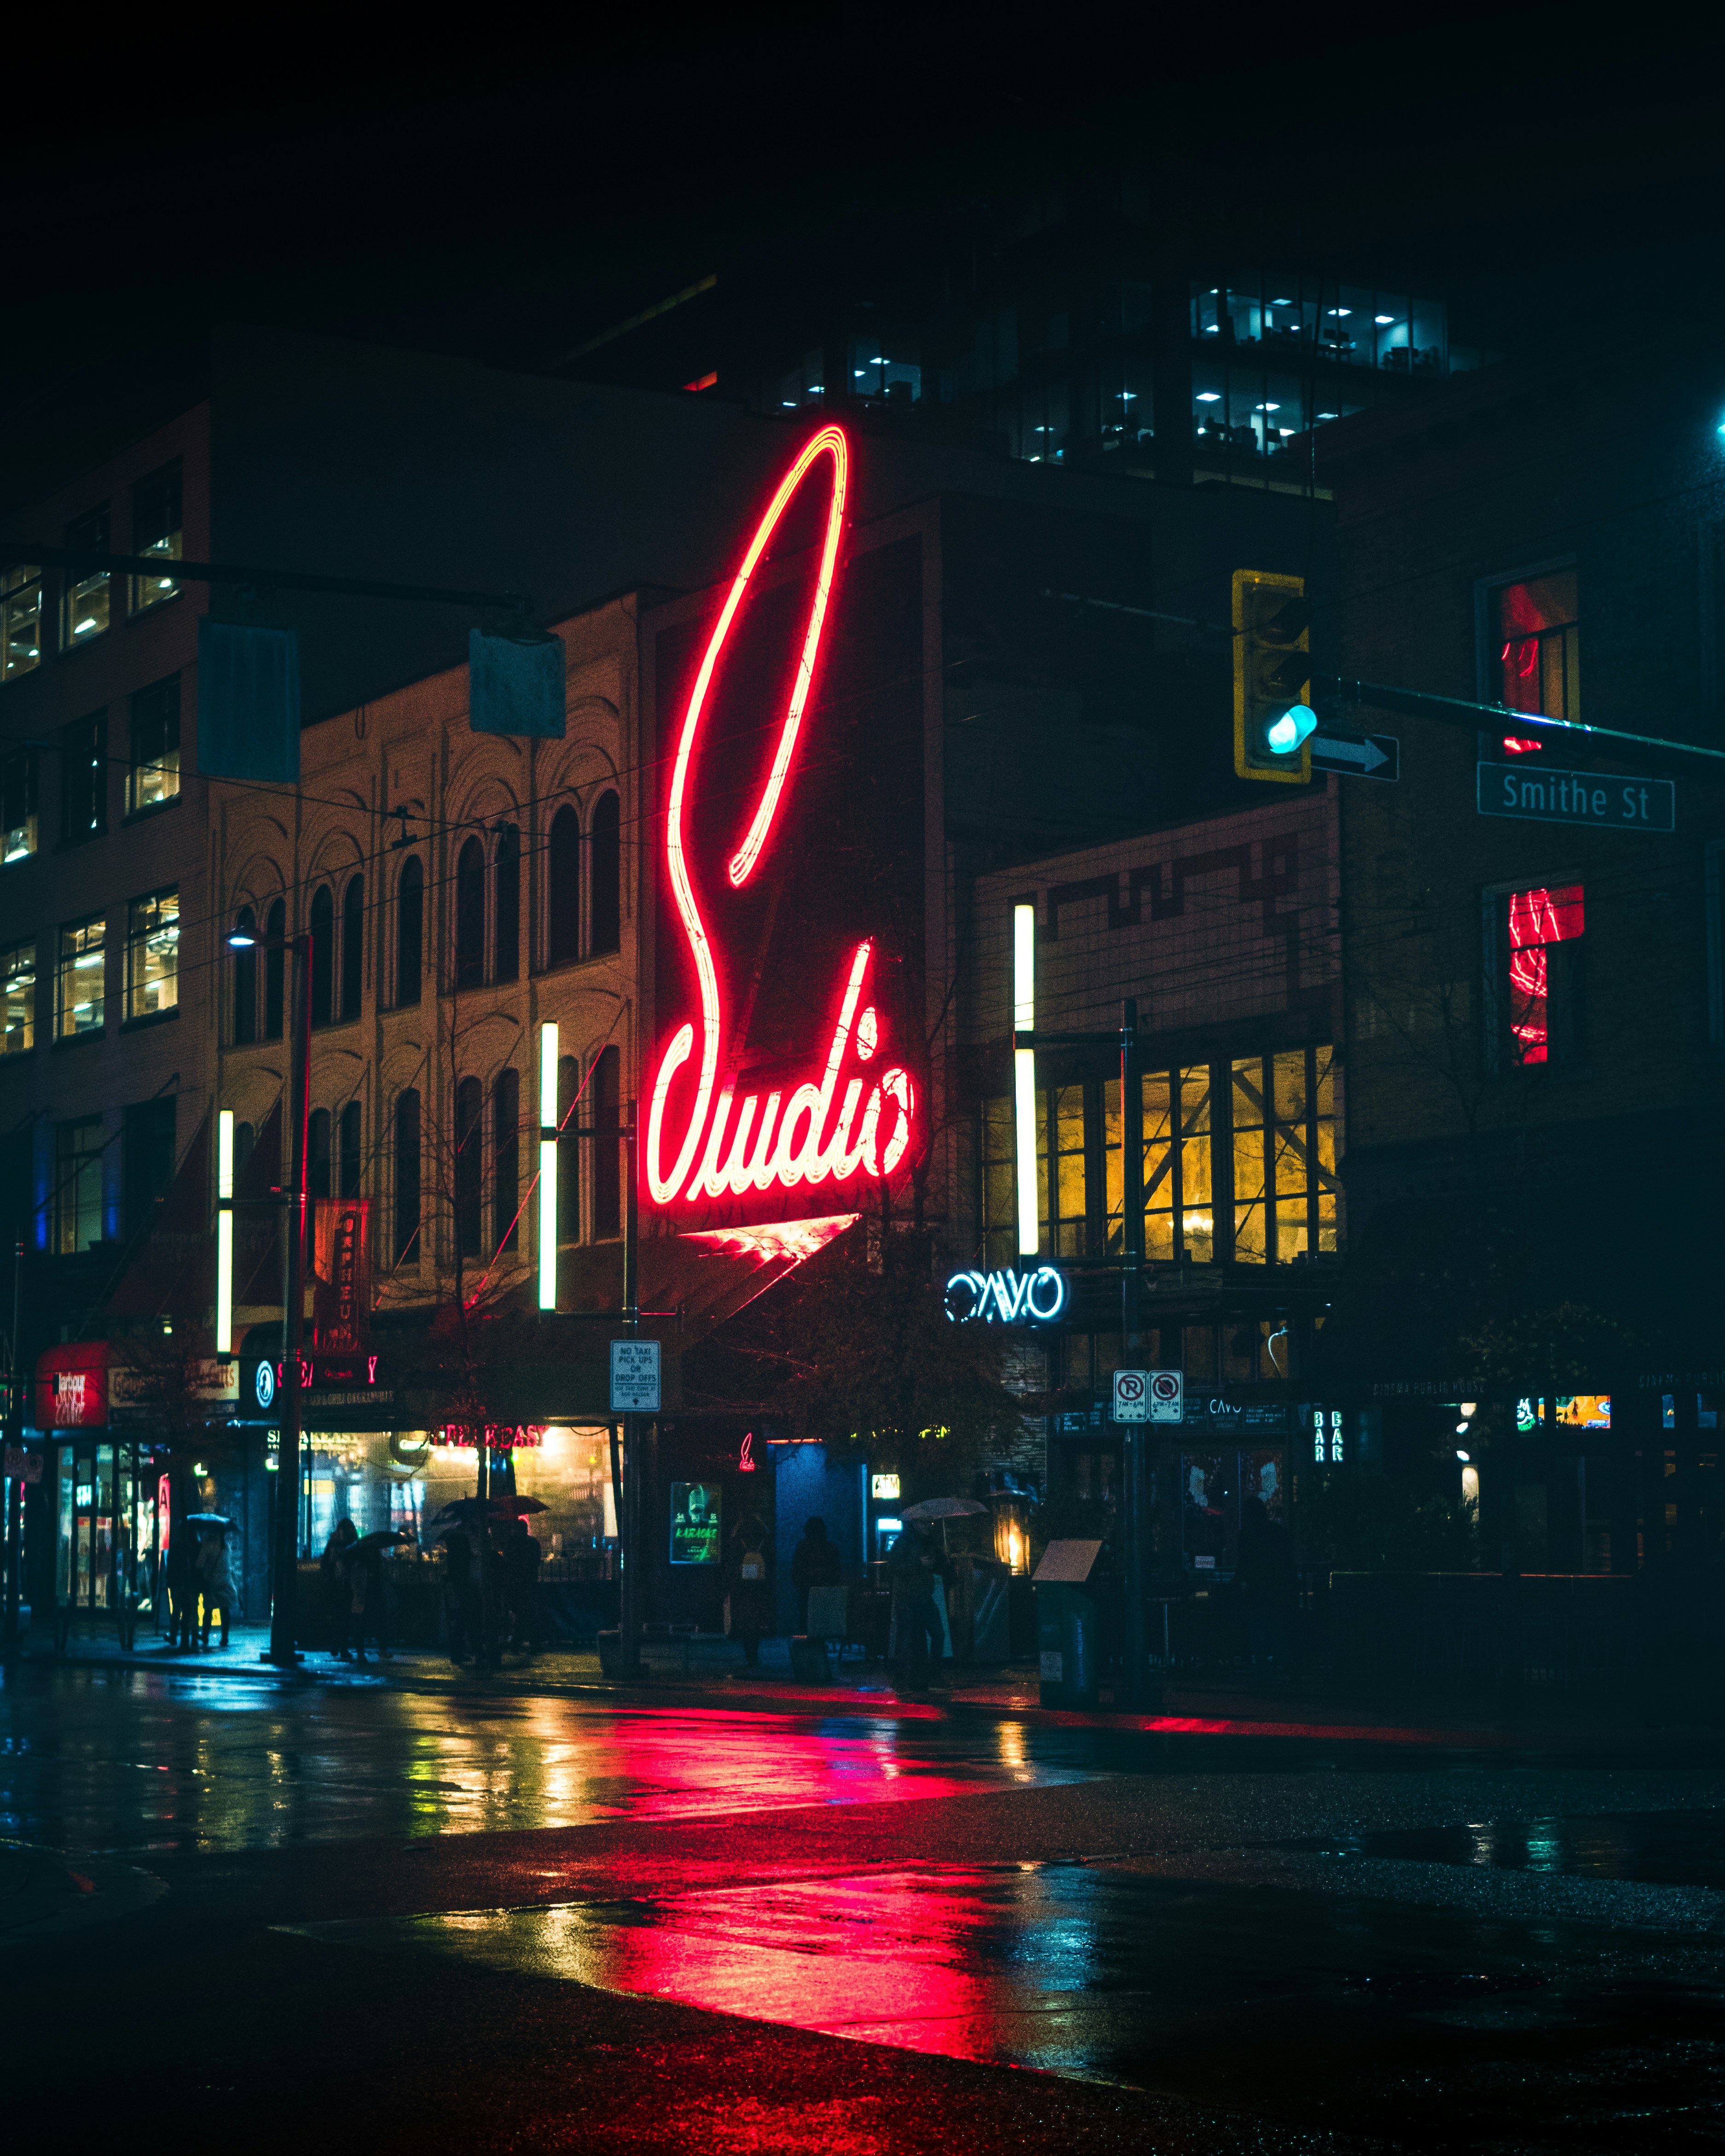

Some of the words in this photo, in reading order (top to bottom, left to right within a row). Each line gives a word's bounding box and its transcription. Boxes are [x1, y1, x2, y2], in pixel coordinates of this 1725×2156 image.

[1503, 774, 1607, 816] Smithe
[1622, 786, 1649, 821] St
[635, 1346, 651, 1355] TAXI
[615, 1374, 636, 1382] DROP
[267, 1429, 358, 1444] SAKEASY
[1314, 1411, 1324, 1462] BAR
[1331, 1411, 1343, 1462] BAR
[875, 1477, 898, 1490] ATM
